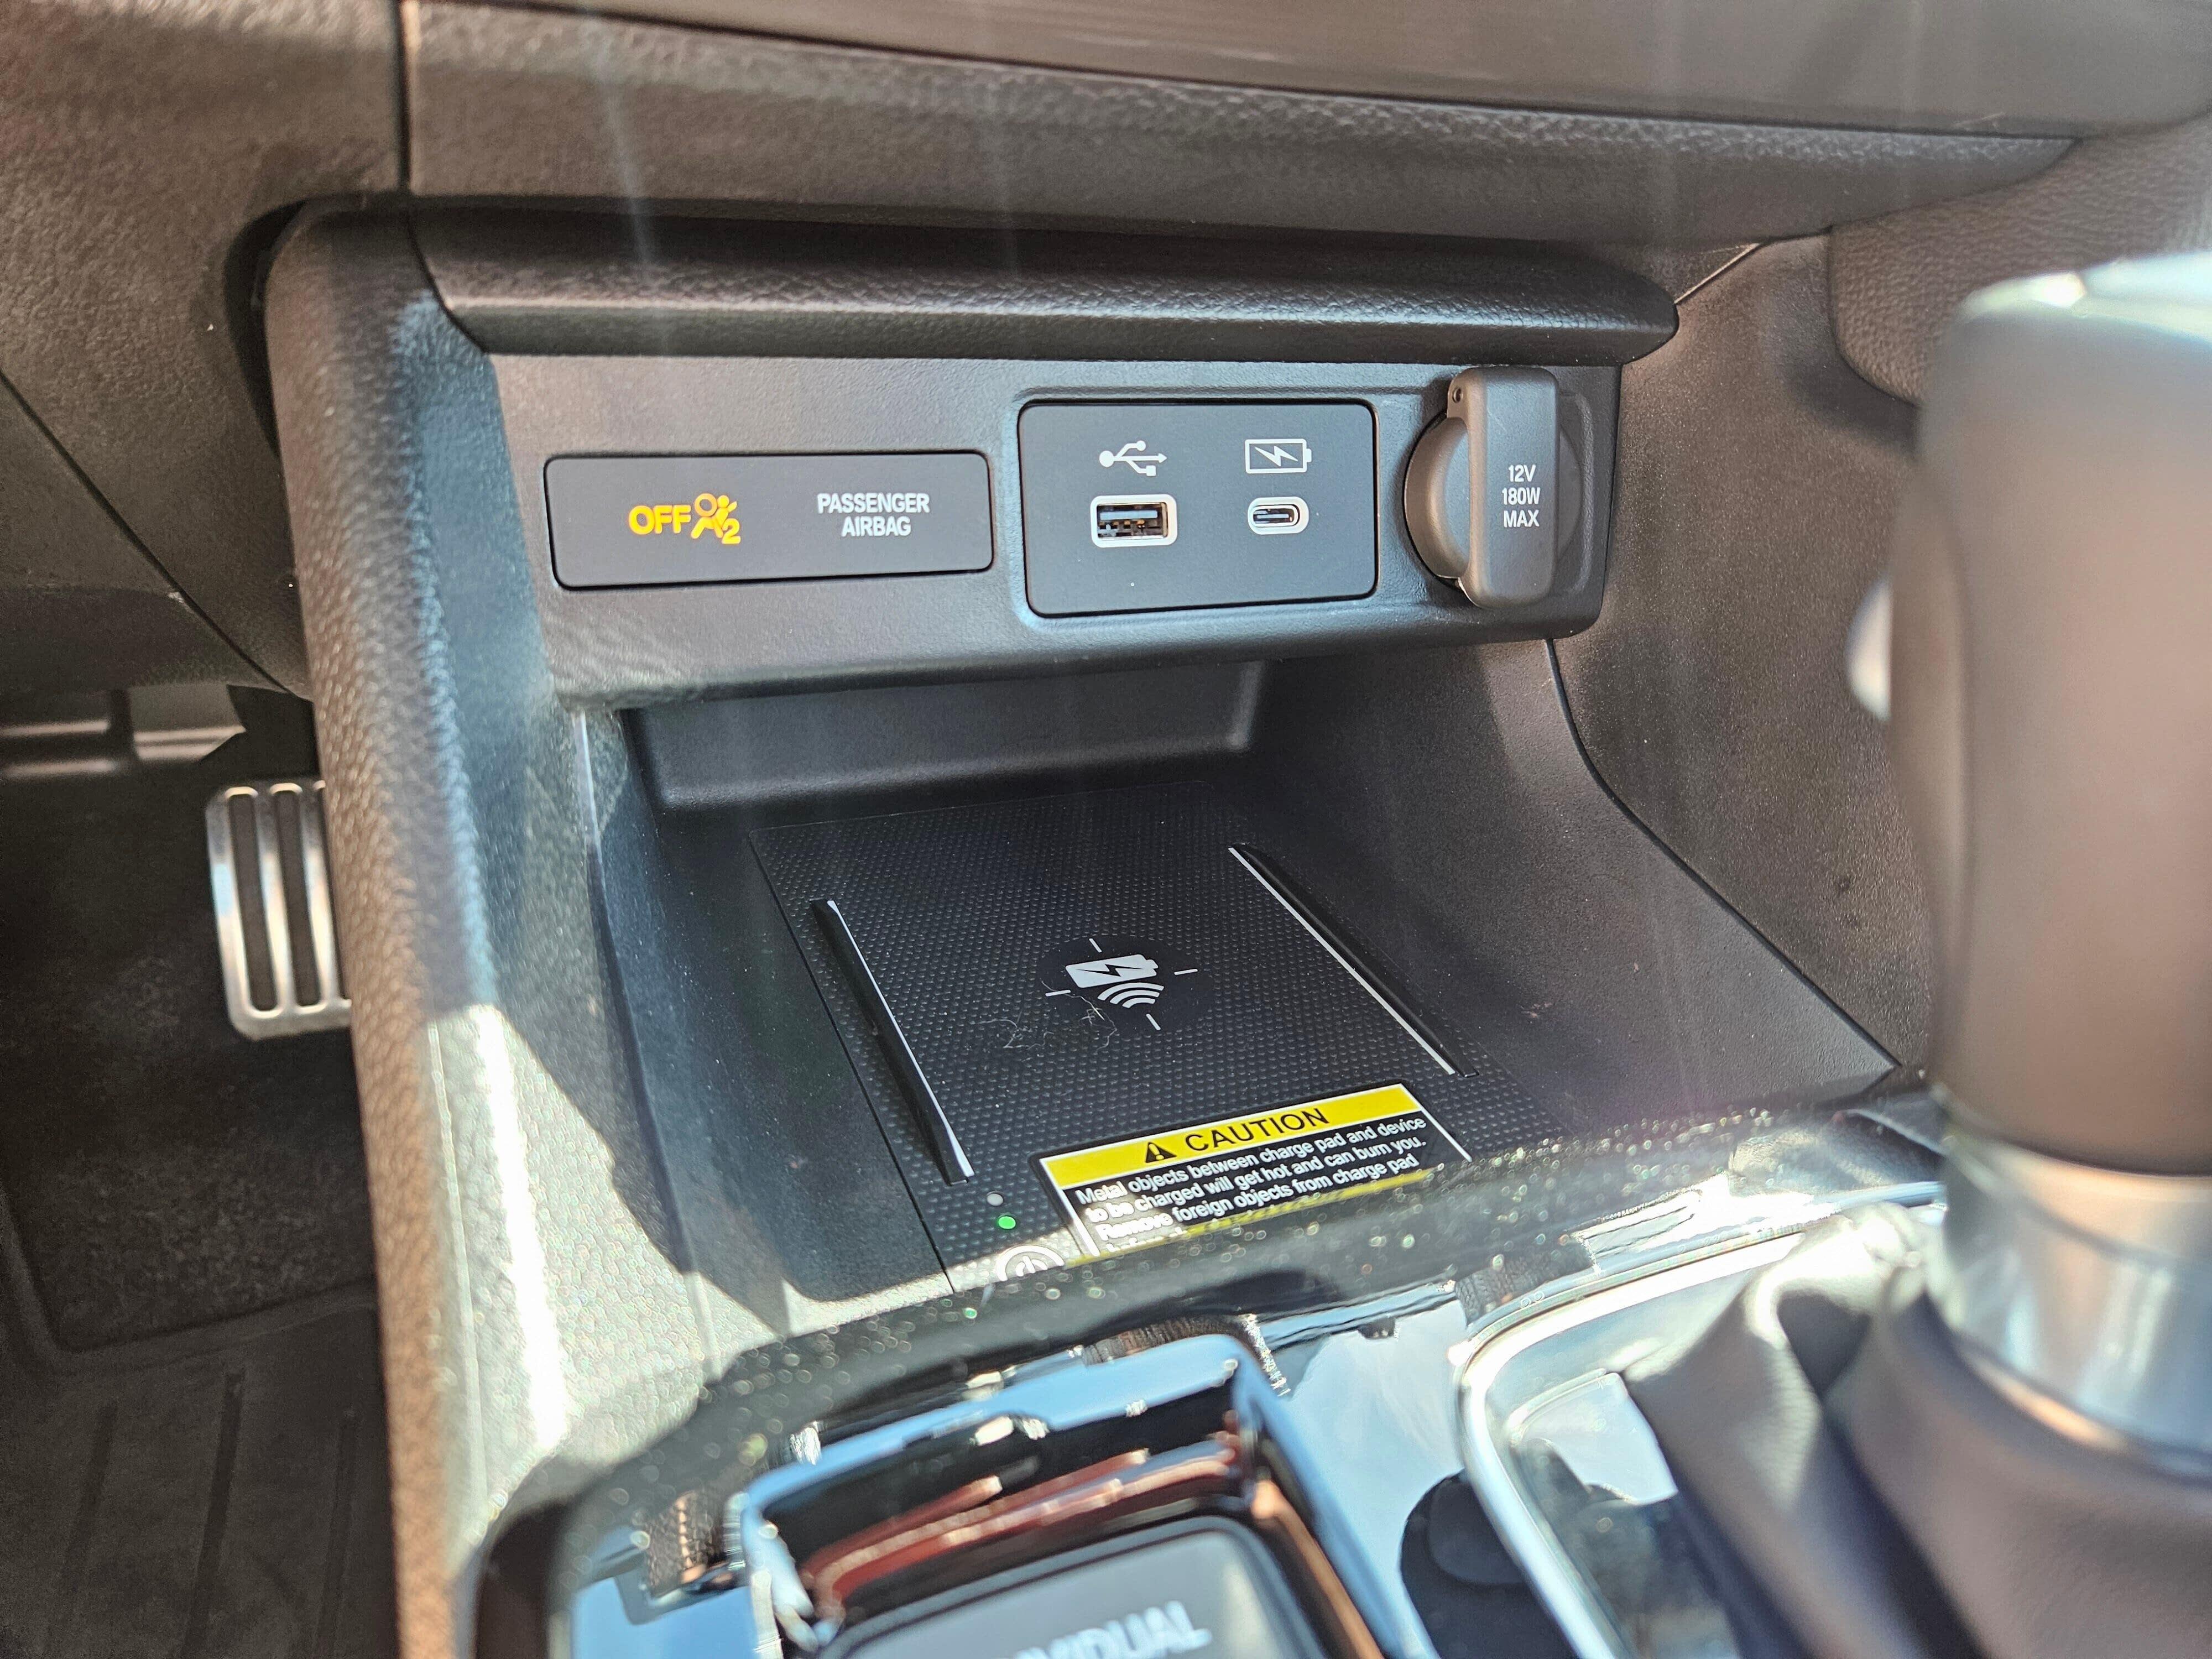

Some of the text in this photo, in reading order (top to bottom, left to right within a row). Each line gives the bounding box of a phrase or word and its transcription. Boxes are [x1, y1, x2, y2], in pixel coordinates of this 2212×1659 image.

[1508, 465, 1537, 482] 12V
[817, 492, 930, 514] PASSENGER
[1502, 487, 1540, 505] 180W
[629, 505, 691, 535] OFF
[841, 515, 912, 537] AIRBAG
[1504, 510, 1540, 528] MAX
[1185, 1108, 1330, 1151] CAUTION
[1075, 1117, 1427, 1204] Metal objects between charge pad and device
[1085, 1136, 1427, 1223] to be charged will get hot and can burn you.
[1095, 1213, 1174, 1241] Remove
[1172, 1197, 1234, 1222] foreign
[1234, 1184, 1293, 1207] objects
[1292, 1175, 1333, 1193] from
[1333, 1162, 1387, 1185] charge
[1386, 1153, 1420, 1174] pad
